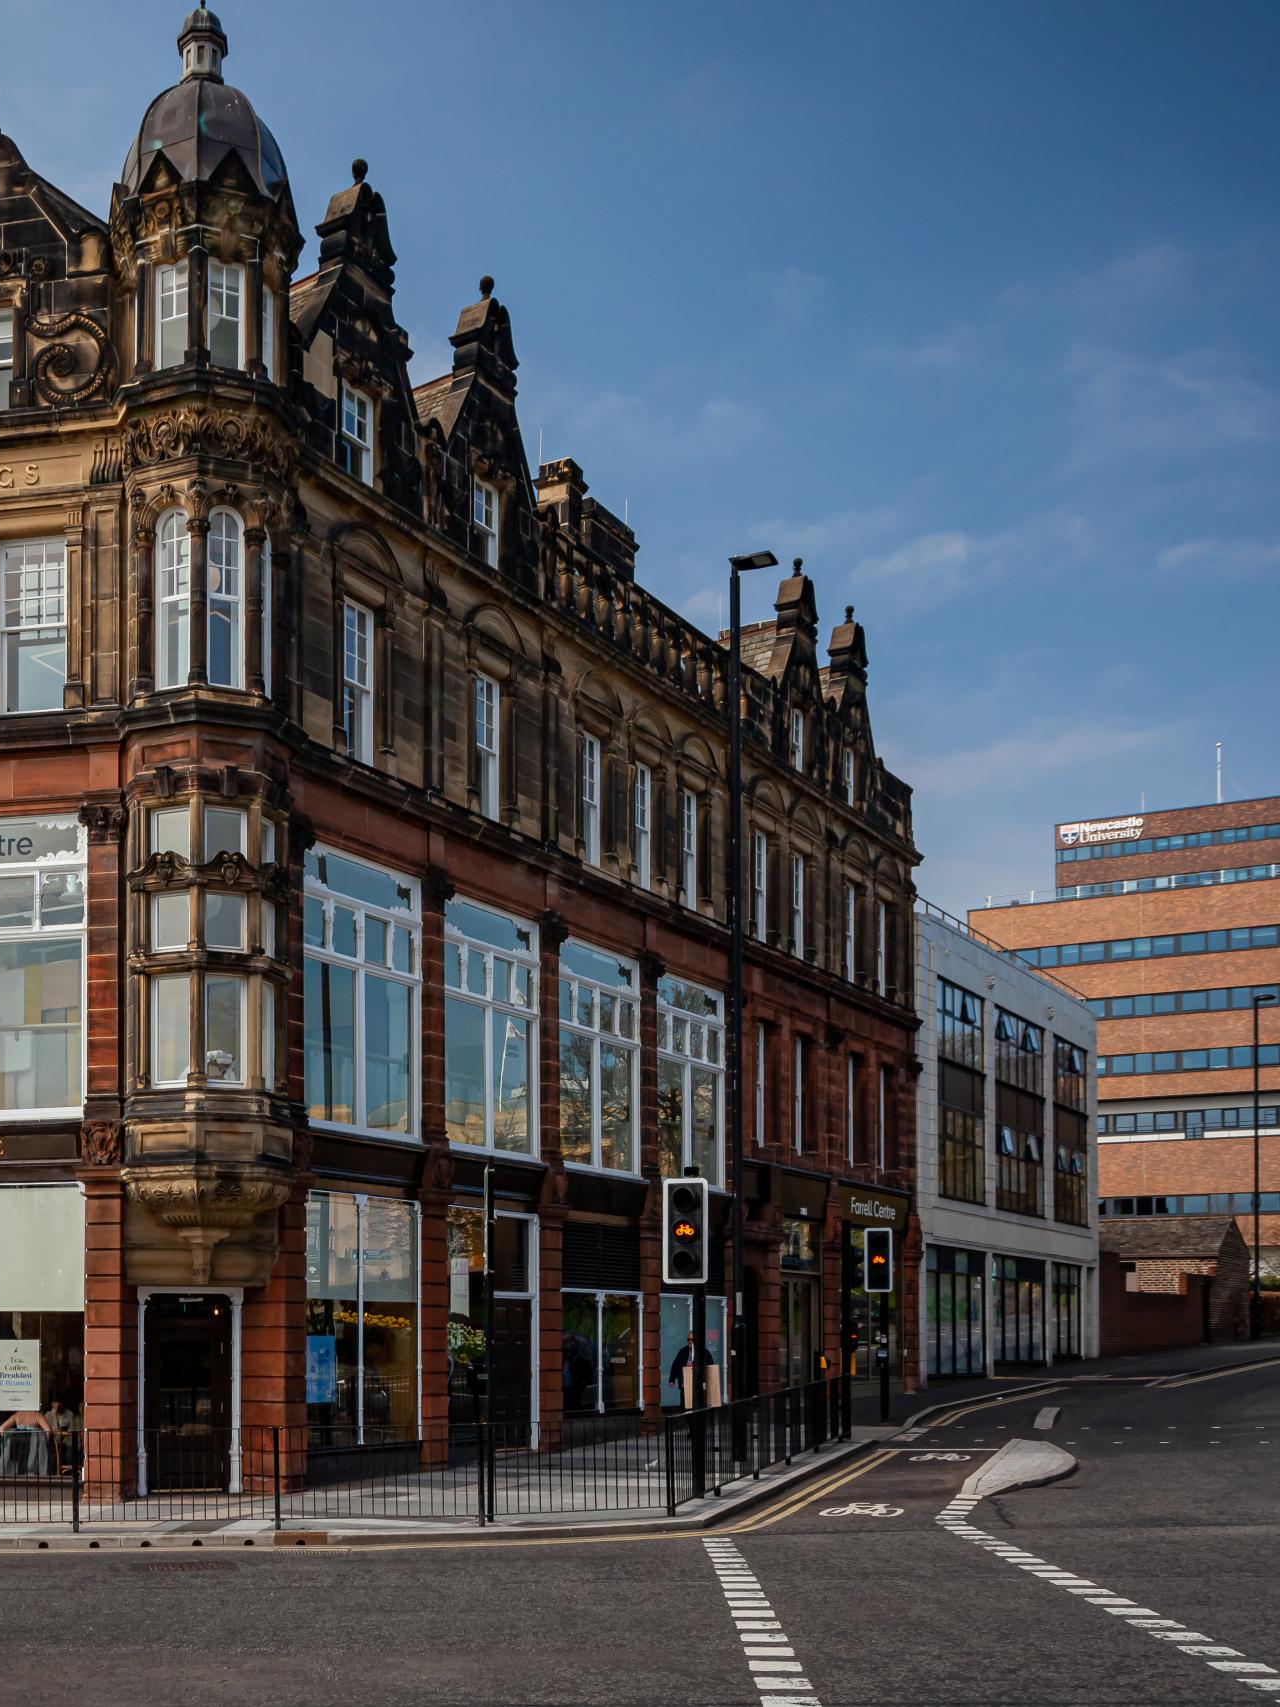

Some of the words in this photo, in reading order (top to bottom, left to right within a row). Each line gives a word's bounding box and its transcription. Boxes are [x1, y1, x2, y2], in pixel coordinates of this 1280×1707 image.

[1080, 817, 1144, 833] Newcastle
[1080, 828, 1143, 843] University
[850, 1196, 873, 1216] Farrell
[873, 1200, 896, 1220] Centre
[0, 1371, 32, 1379] Breakfast
